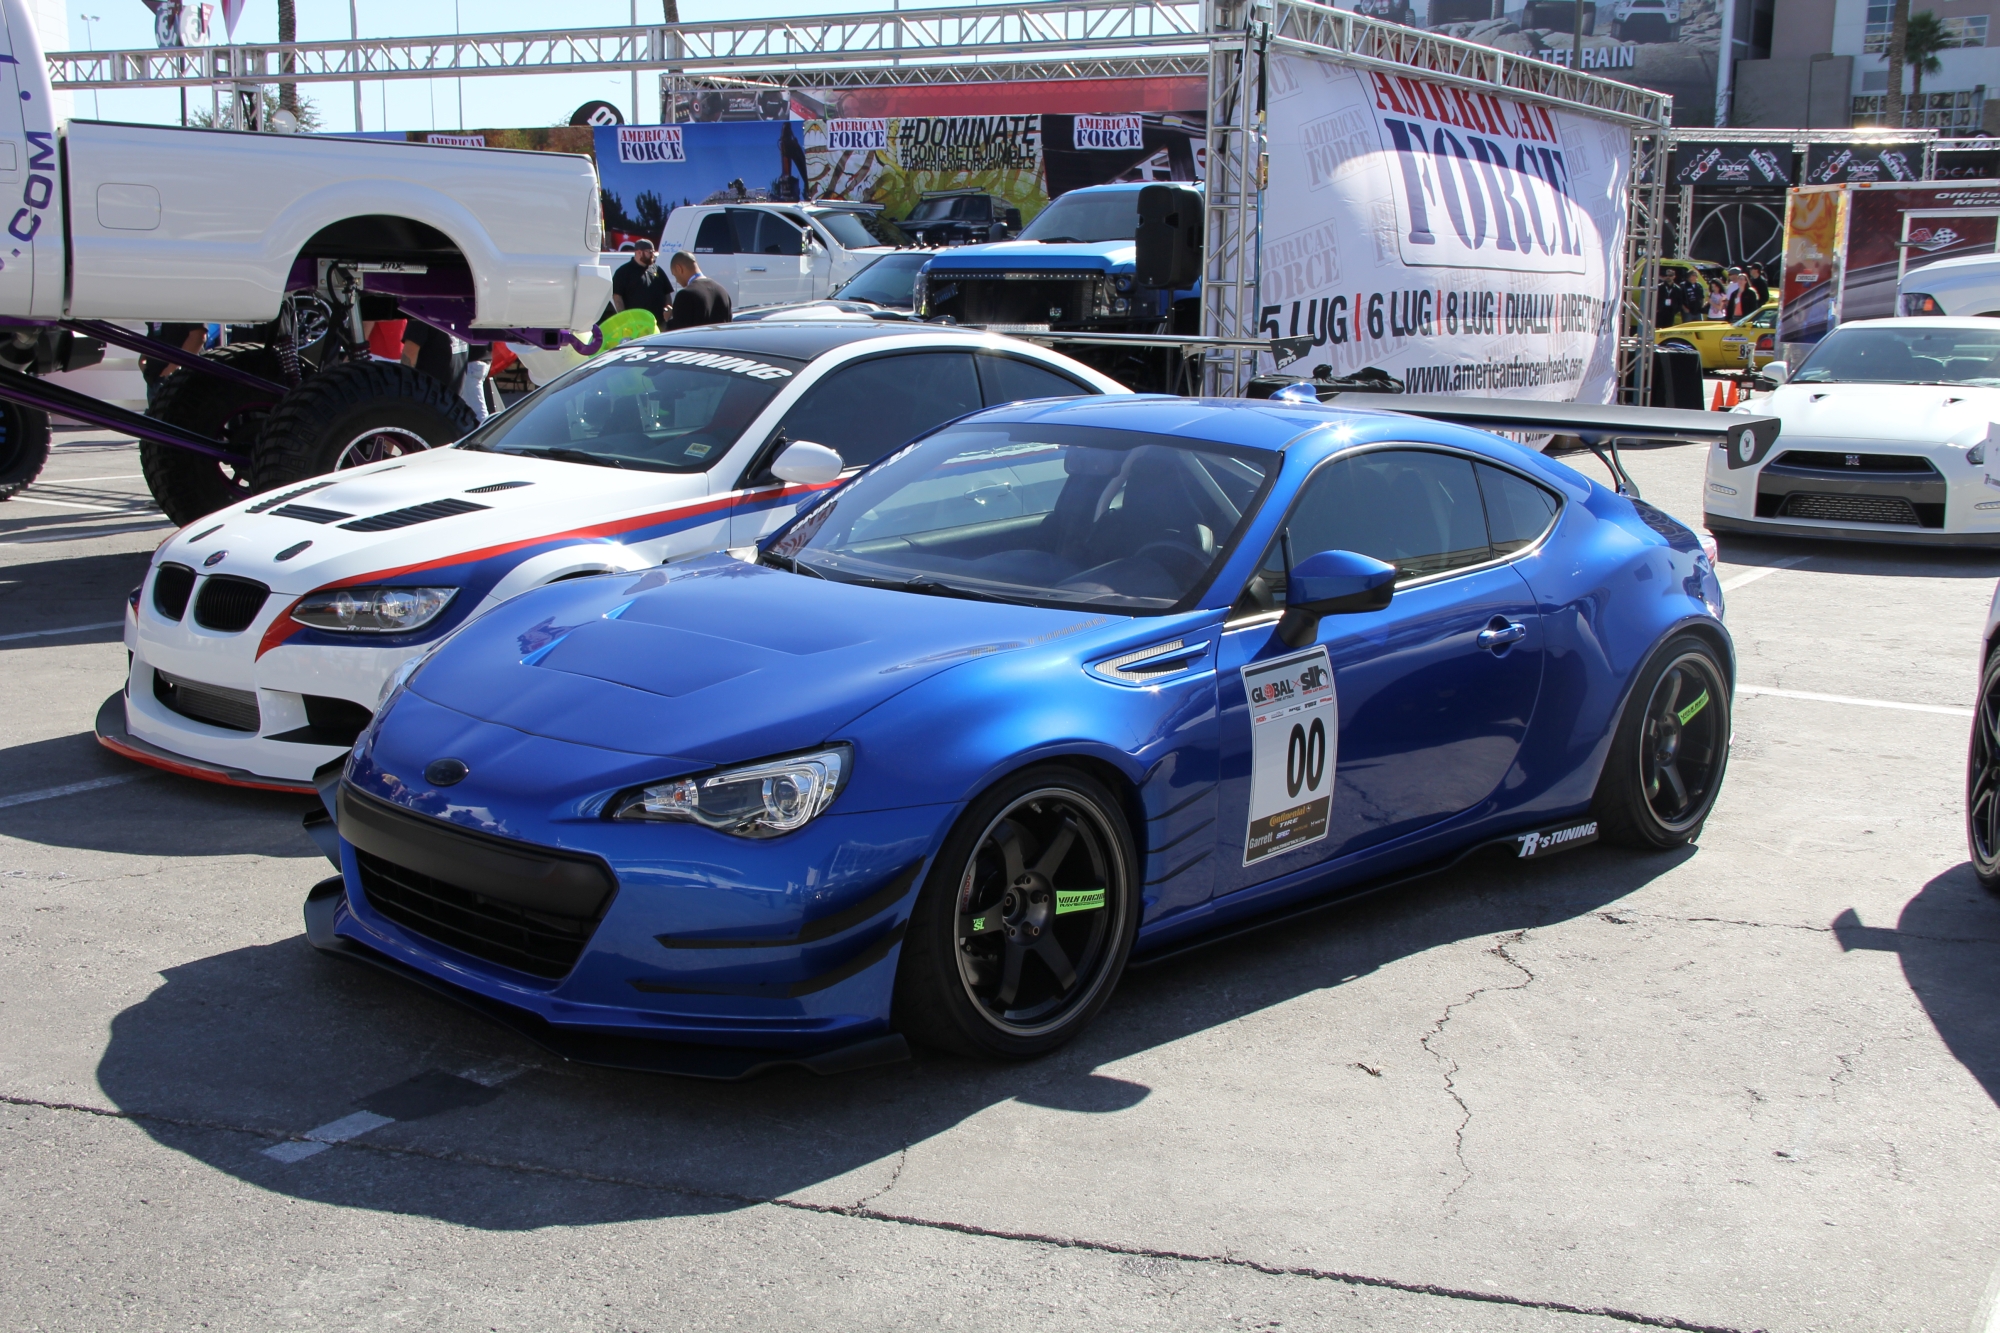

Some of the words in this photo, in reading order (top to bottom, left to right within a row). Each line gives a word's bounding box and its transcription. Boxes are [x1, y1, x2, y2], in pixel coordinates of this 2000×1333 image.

[1367, 45, 1558, 144] AMERICAN
[829, 120, 885, 132] AMERICAN
[900, 114, 1039, 148] #DOMINATE
[1076, 117, 1140, 130] AMERICAN
[1304, 108, 1368, 150] AMERICAN
[621, 129, 680, 142] AMERICAN
[829, 131, 885, 148] FORCE
[1076, 129, 1140, 148] FORCE
[621, 142, 683, 161] FORCE
[901, 142, 1036, 161] #CONCRETEJUNGLE
[1306, 131, 1379, 187] FORCE
[902, 159, 1035, 172] #AMERICANFORCEWHEELS
[1748, 149, 1775, 182] ULTRA
[1879, 149, 1904, 182] ULTRA
[1935, 166, 1987, 178] OCAL
[1384, 118, 1582, 257] FORCE
[1935, 191, 2000, 199] Officia
[1290, 296, 1347, 347] LUG
[1367, 293, 1384, 339] 6
[1391, 290, 1432, 337] LUG
[1446, 292, 1458, 335] 8
[1463, 291, 1494, 335] LUG
[1505, 293, 1554, 334] DUALLY
[1561, 293, 1592, 333] DIRECT
[649, 350, 793, 380] TUNING
[1406, 353, 1583, 394] www.americanforcewheels.com
[1252, 679, 1294, 703] GLOBAL
[1287, 717, 1326, 799] 00
[1269, 805, 1306, 827] Continental
[1280, 817, 1299, 829] TIRE
[1249, 832, 1274, 850] Garrett
[1276, 829, 1291, 840] SPEC
[1550, 822, 1598, 846] TUNING
